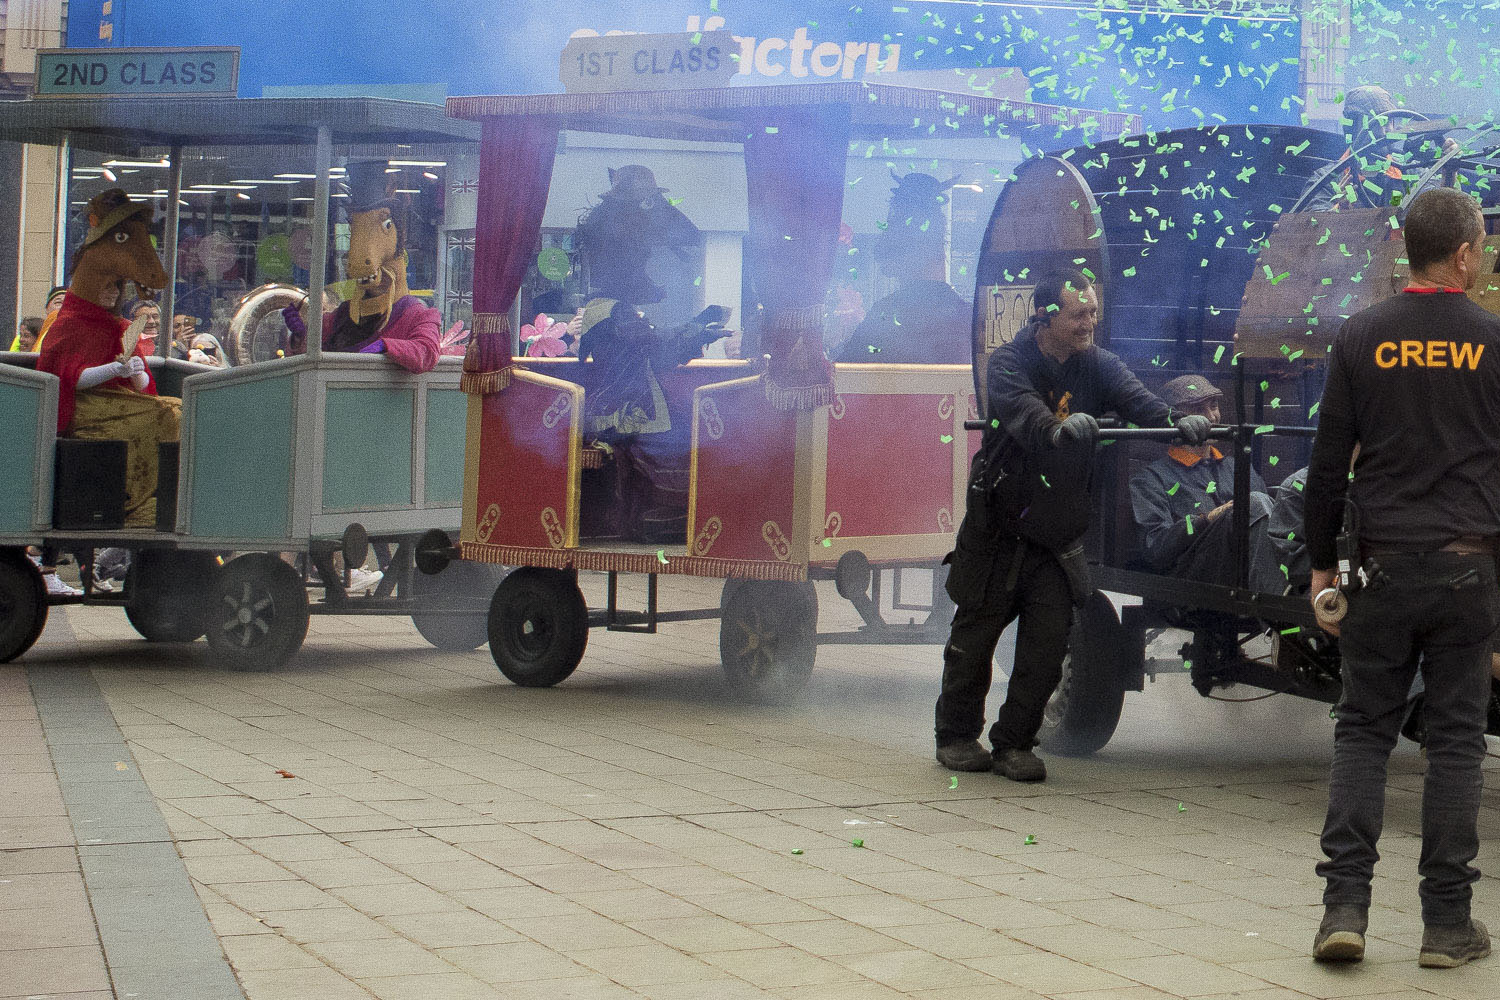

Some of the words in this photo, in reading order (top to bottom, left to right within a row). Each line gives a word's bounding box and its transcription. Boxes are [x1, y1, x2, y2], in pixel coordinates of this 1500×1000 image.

[53, 62, 108, 86] 2ND
[120, 61, 217, 85] CLASS
[576, 50, 619, 77] 1ST
[633, 46, 721, 75] CLASS
[1375, 340, 1485, 370] CREW
